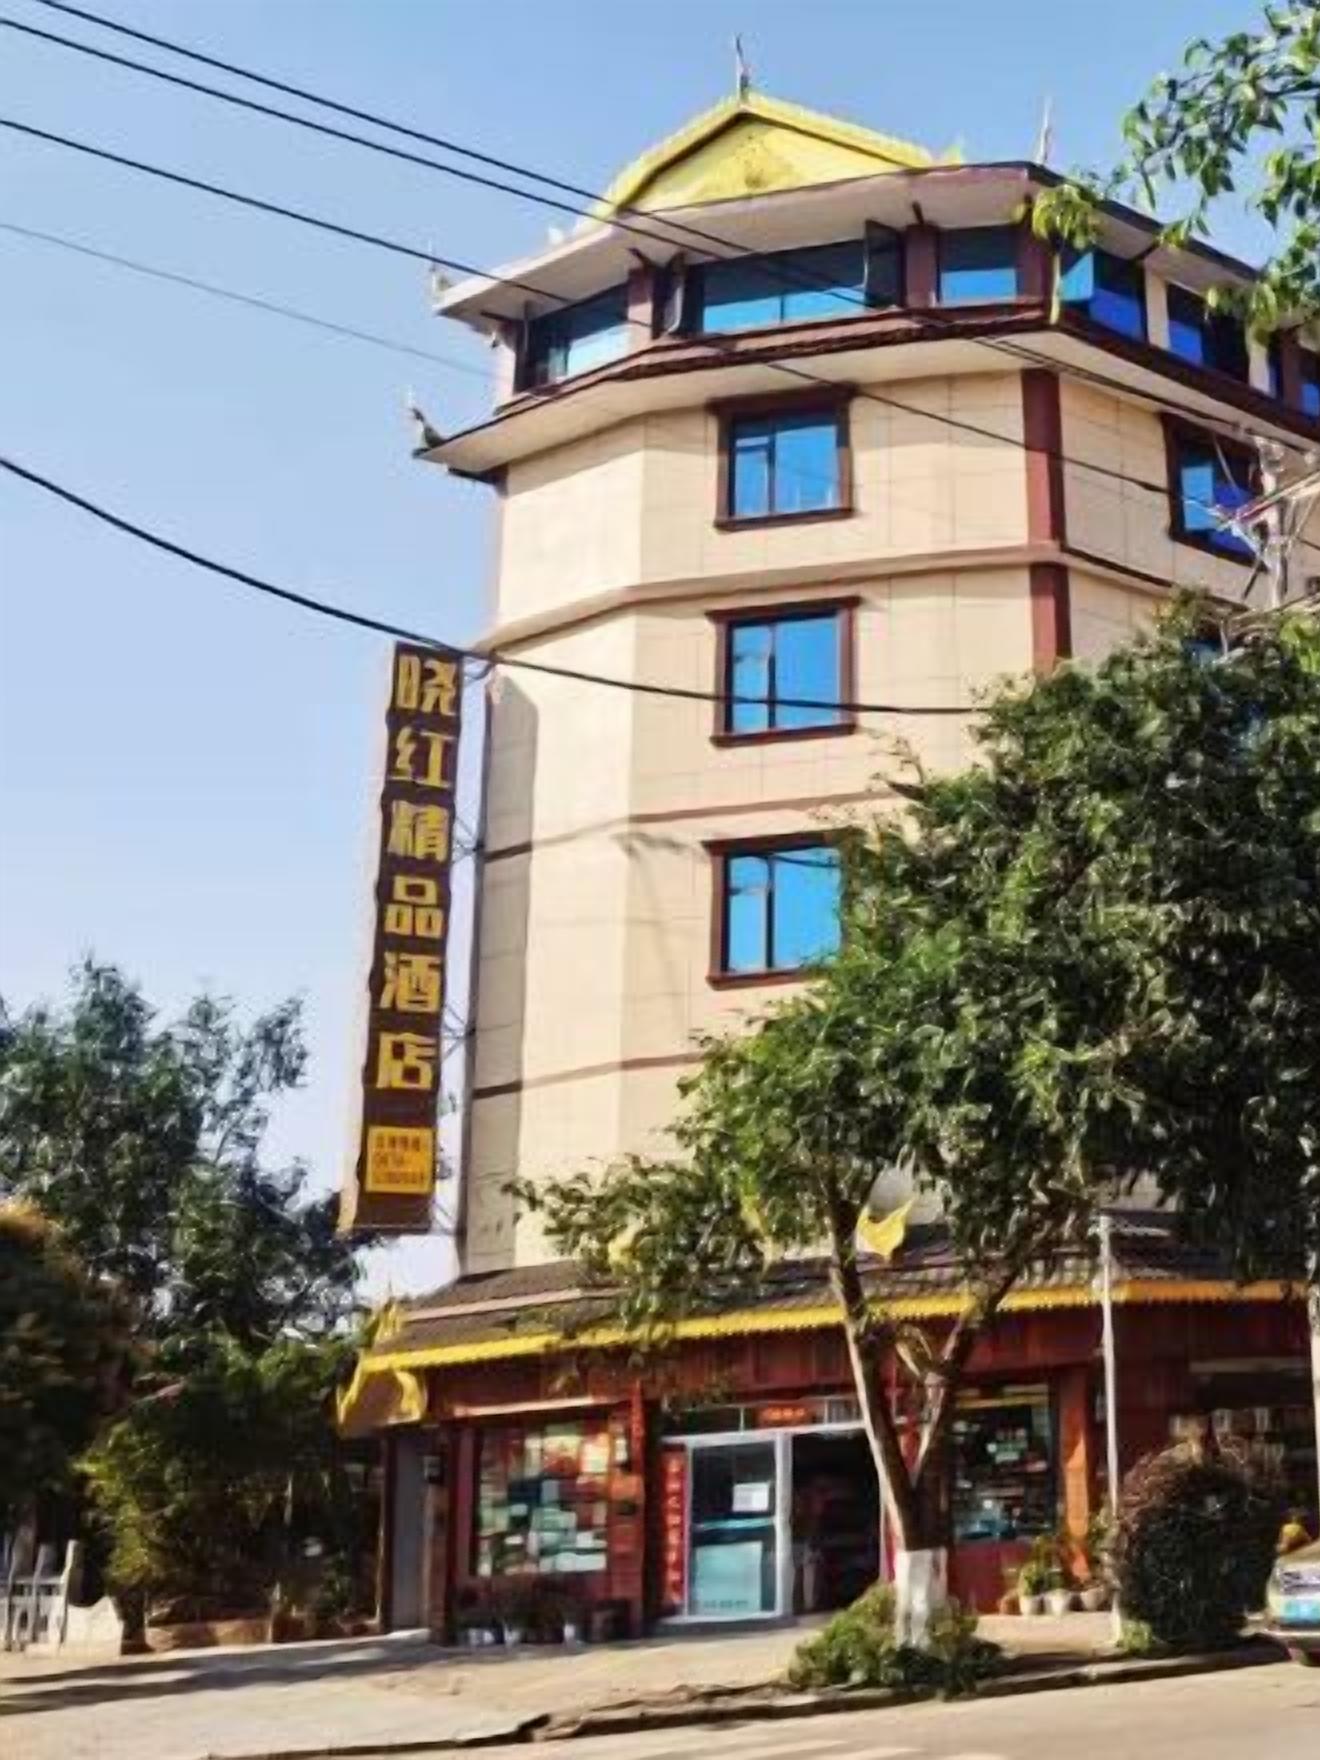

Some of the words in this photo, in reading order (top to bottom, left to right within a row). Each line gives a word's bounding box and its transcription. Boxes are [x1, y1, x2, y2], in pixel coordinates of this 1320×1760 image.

[376, 655, 457, 1090] 晓红精品酒店
